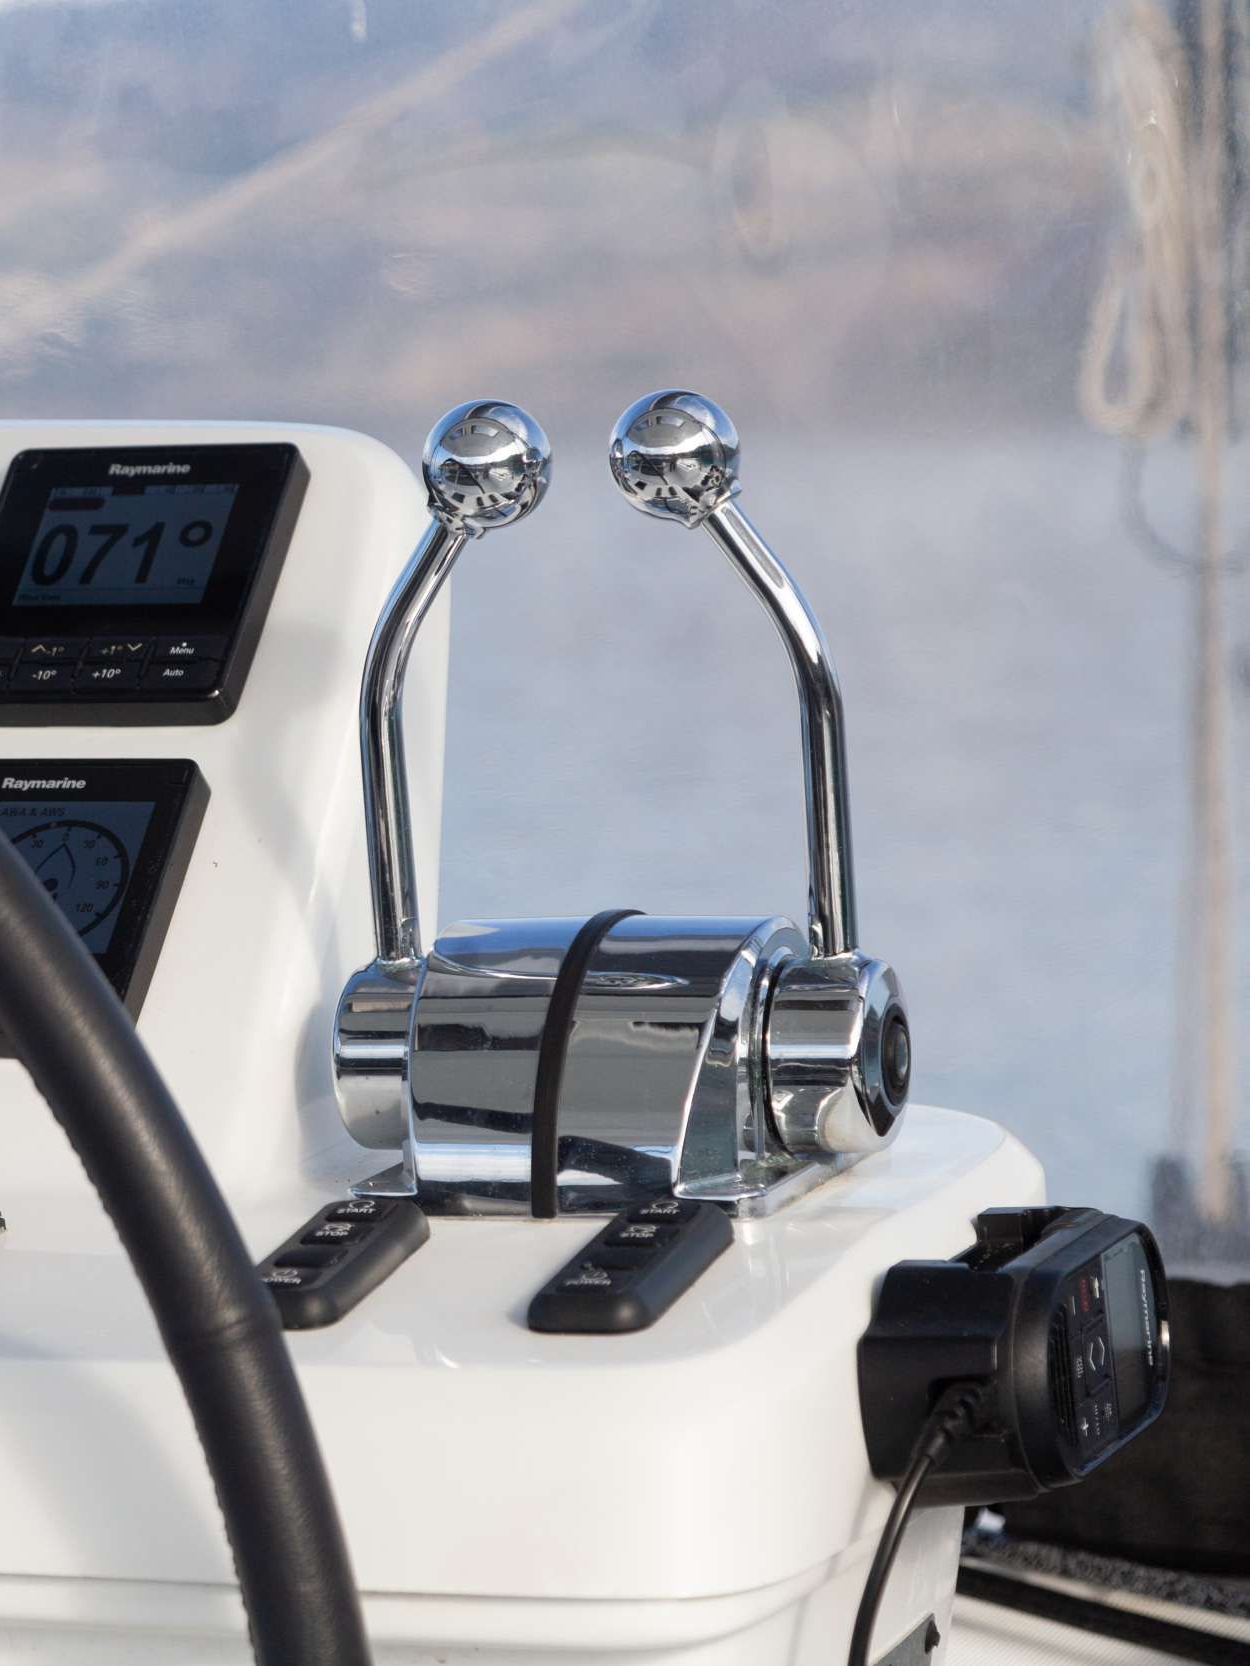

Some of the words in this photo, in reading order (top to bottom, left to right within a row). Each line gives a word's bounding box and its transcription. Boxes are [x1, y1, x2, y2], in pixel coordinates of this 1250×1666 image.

[108, 461, 191, 478] Raymarine
[31, 521, 214, 586] 071°
[169, 645, 195, 655] Menu
[32, 670, 57, 681] -10°
[92, 668, 122, 680] +10°
[163, 668, 185, 677] Auto
[1, 776, 87, 792] Raymarine
[336, 1207, 376, 1215] START
[639, 1207, 680, 1215] START
[565, 1278, 612, 1287] POWER
[1140, 1269, 1154, 1366] Raymarine
